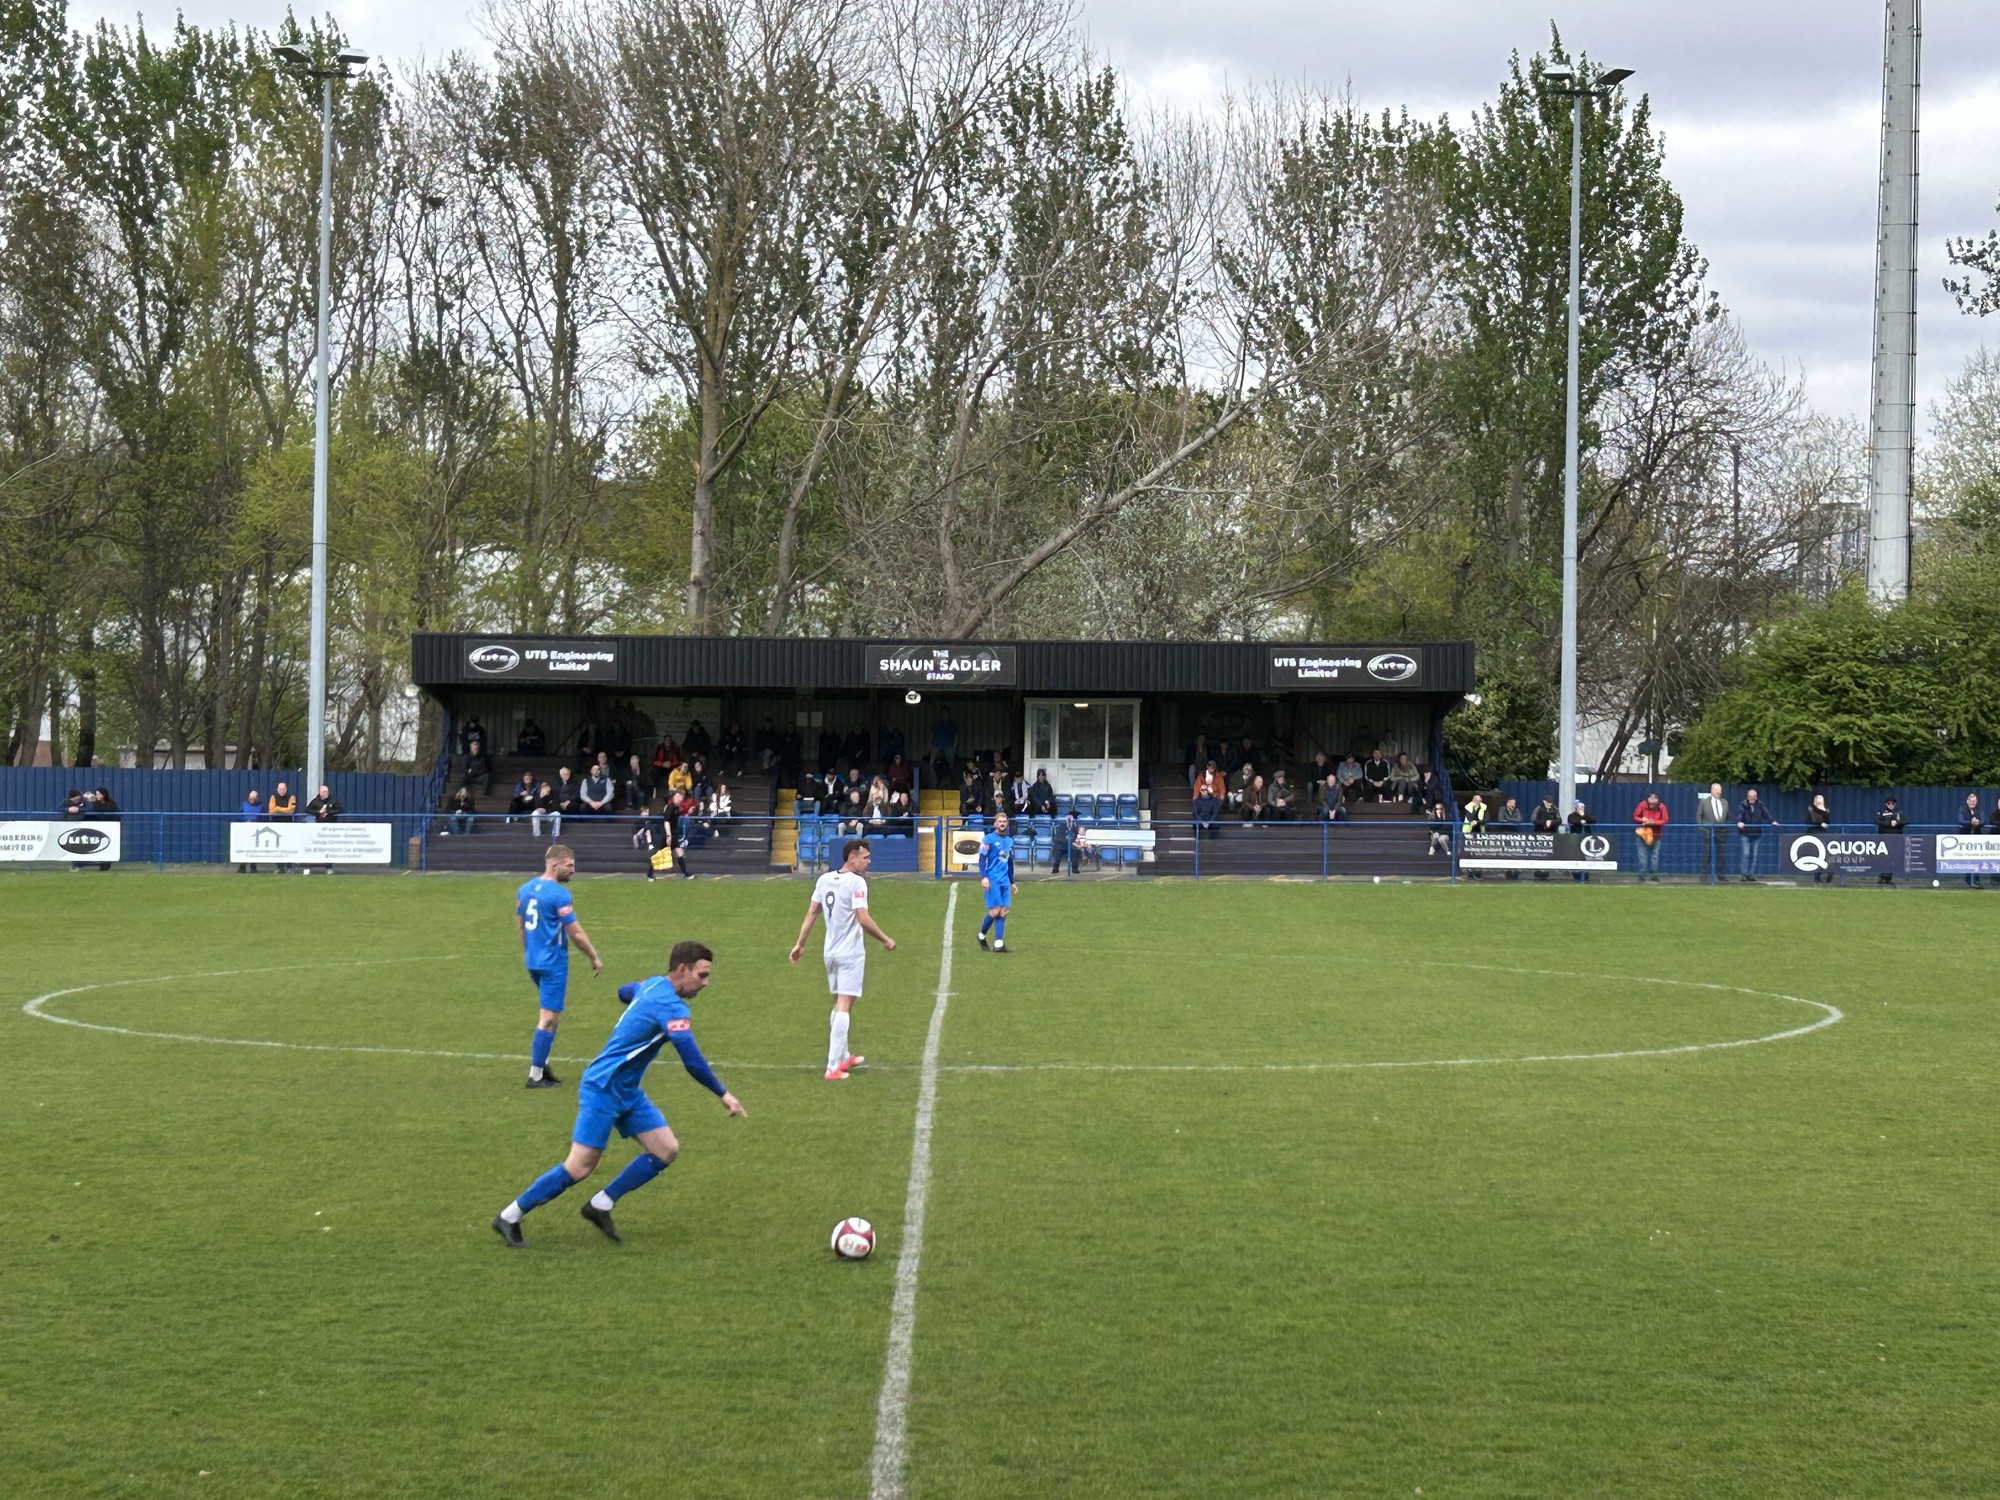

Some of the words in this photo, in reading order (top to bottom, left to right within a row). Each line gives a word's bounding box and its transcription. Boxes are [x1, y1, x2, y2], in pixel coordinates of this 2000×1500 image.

[525, 650, 548, 660] UTS
[550, 651, 614, 662] Engineering
[932, 650, 949, 658] THE
[549, 662, 590, 671] Limited
[880, 659, 934, 671] SHAUN
[939, 659, 1001, 671] SADLER
[1274, 657, 1296, 667] UTS
[1299, 657, 1362, 668] Engineering
[926, 672, 955, 681] STAND
[1298, 669, 1338, 678] Limited
[1827, 841, 1888, 855] QUORA
[826, 891, 835, 919] 9
[525, 898, 538, 930] 5
